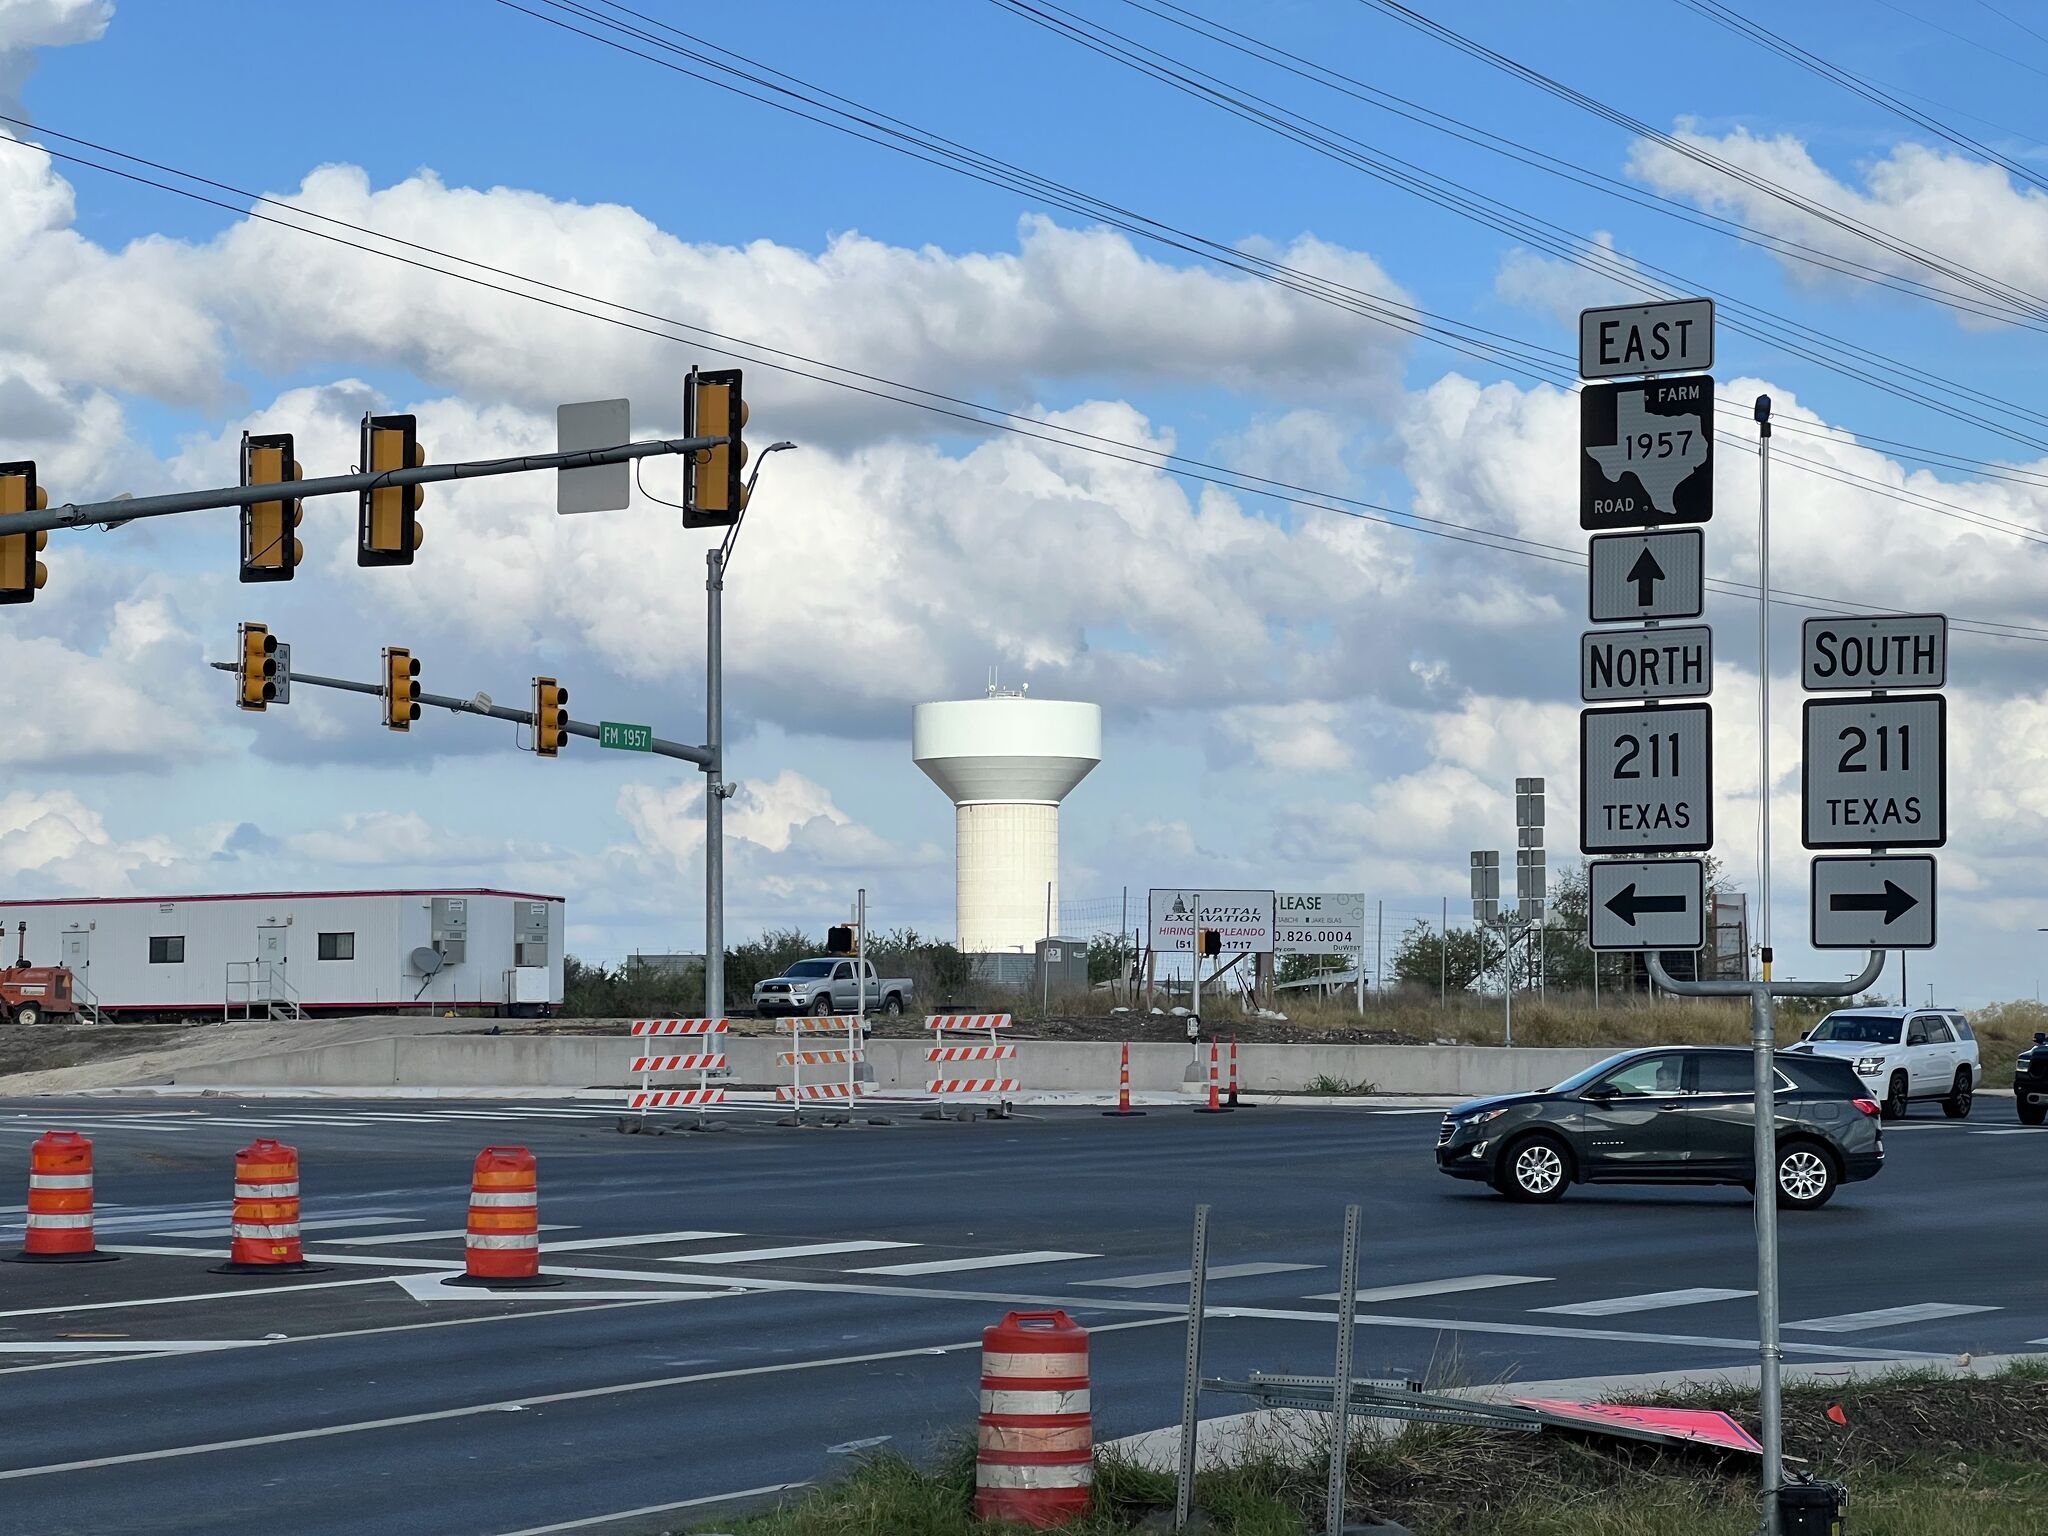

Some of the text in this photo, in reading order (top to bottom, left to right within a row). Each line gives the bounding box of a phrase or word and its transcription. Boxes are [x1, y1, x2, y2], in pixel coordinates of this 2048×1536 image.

[1599, 319, 1693, 366] EAST
[1658, 385, 1700, 402] FARM
[1625, 430, 1693, 461] 1957
[1594, 498, 1634, 514] ROAD
[1590, 644, 1702, 689] NORTH
[1813, 631, 1935, 678] SOUTH
[604, 726, 647, 747] FM 1957
[1838, 725, 1909, 773] 211
[1613, 732, 1679, 780] 211
[1602, 801, 1690, 831] TEXAS
[1826, 797, 1921, 826] TEXAS
[1280, 896, 1322, 910] LEASE
[1159, 926, 1194, 937] HIRING
[1274, 930, 1352, 942] 0.826.0004
